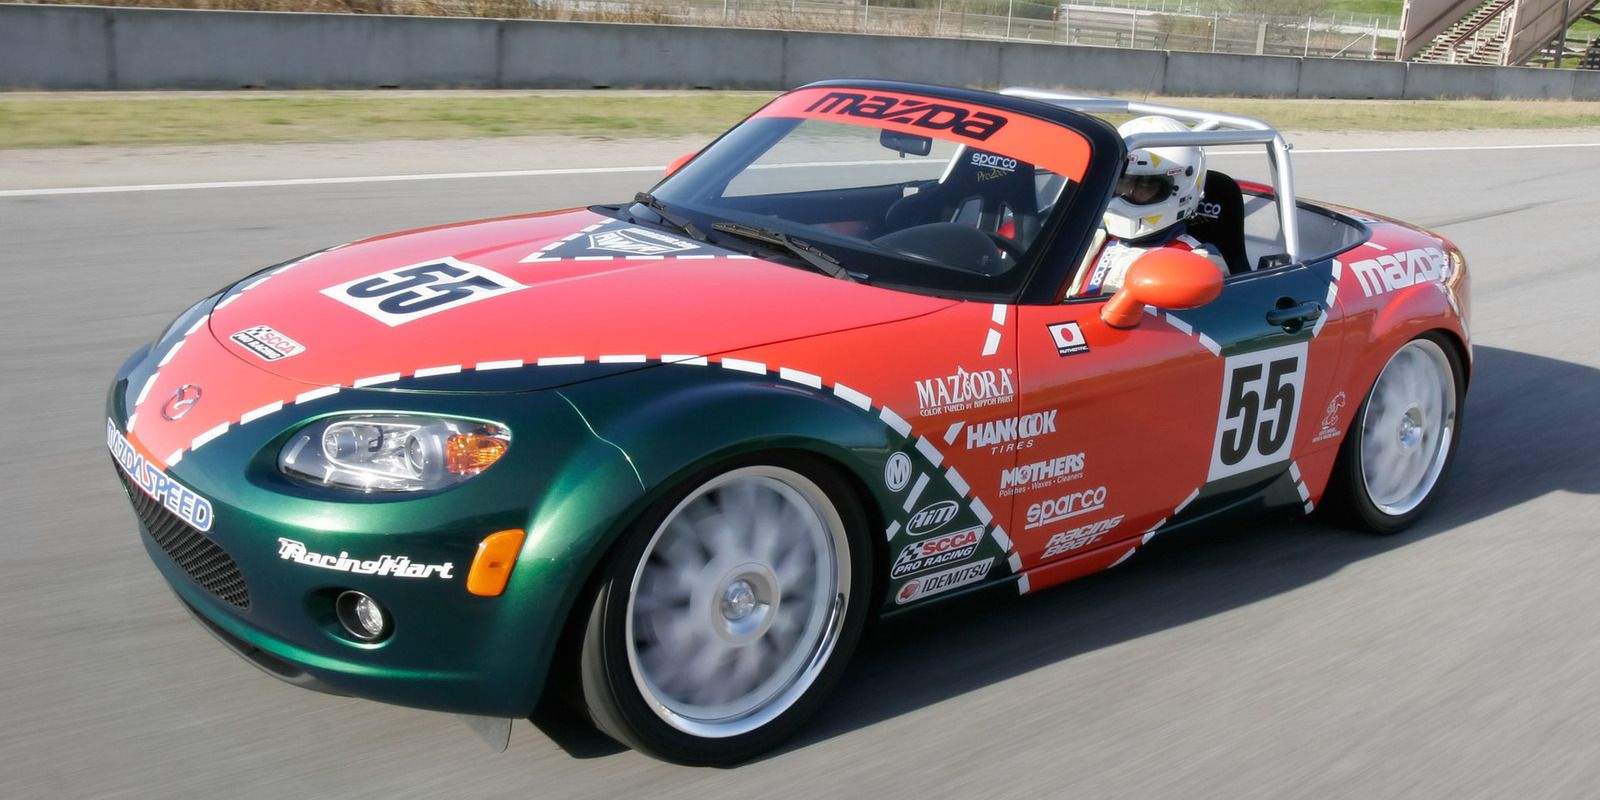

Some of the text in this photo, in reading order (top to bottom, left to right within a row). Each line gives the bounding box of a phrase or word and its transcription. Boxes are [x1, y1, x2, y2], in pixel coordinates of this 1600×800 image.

[805, 91, 1009, 142] mazda
[971, 152, 1018, 170] sparco
[1348, 247, 1446, 298] mazda
[346, 262, 507, 315] 55
[260, 332, 297, 354] SCCA
[920, 408, 942, 417] COLOR
[1220, 356, 1299, 466] 55
[991, 439, 1034, 455] TIRES
[999, 472, 1084, 497] Polishes Waxes Cleaners
[1000, 452, 1085, 489] MOTHERS
[1025, 486, 1107, 528] sparco
[922, 531, 978, 556] SCCA
[894, 545, 974, 576] PRO RACING
[921, 562, 991, 593] IDEMITSU
